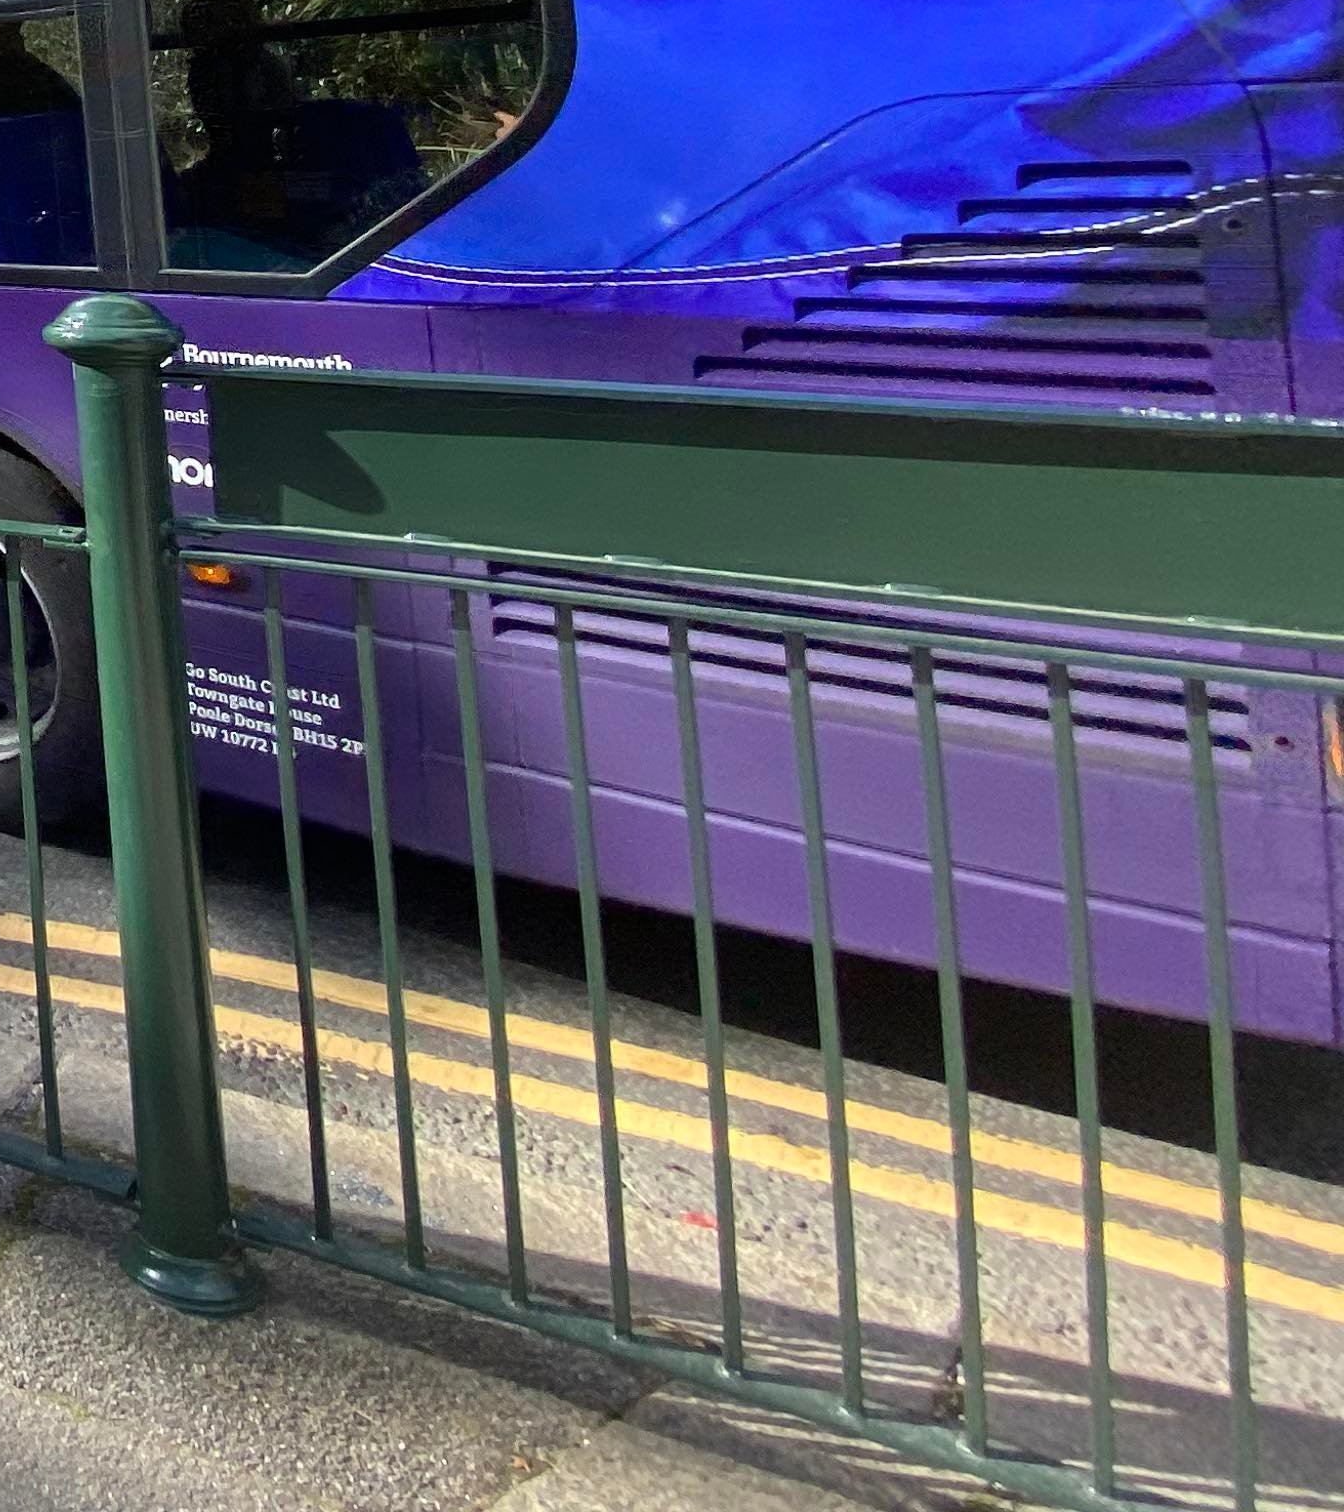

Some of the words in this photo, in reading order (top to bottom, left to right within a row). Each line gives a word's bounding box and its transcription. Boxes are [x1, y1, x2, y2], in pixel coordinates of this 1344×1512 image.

[185, 662, 205, 680] Go
[208, 667, 257, 692] South
[260, 679, 308, 702] Cst
[311, 690, 342, 710] Ltd
[187, 681, 265, 711] Towngate
[189, 701, 231, 724] Poole
[190, 721, 218, 740] UW
[220, 728, 269, 754] 10772
